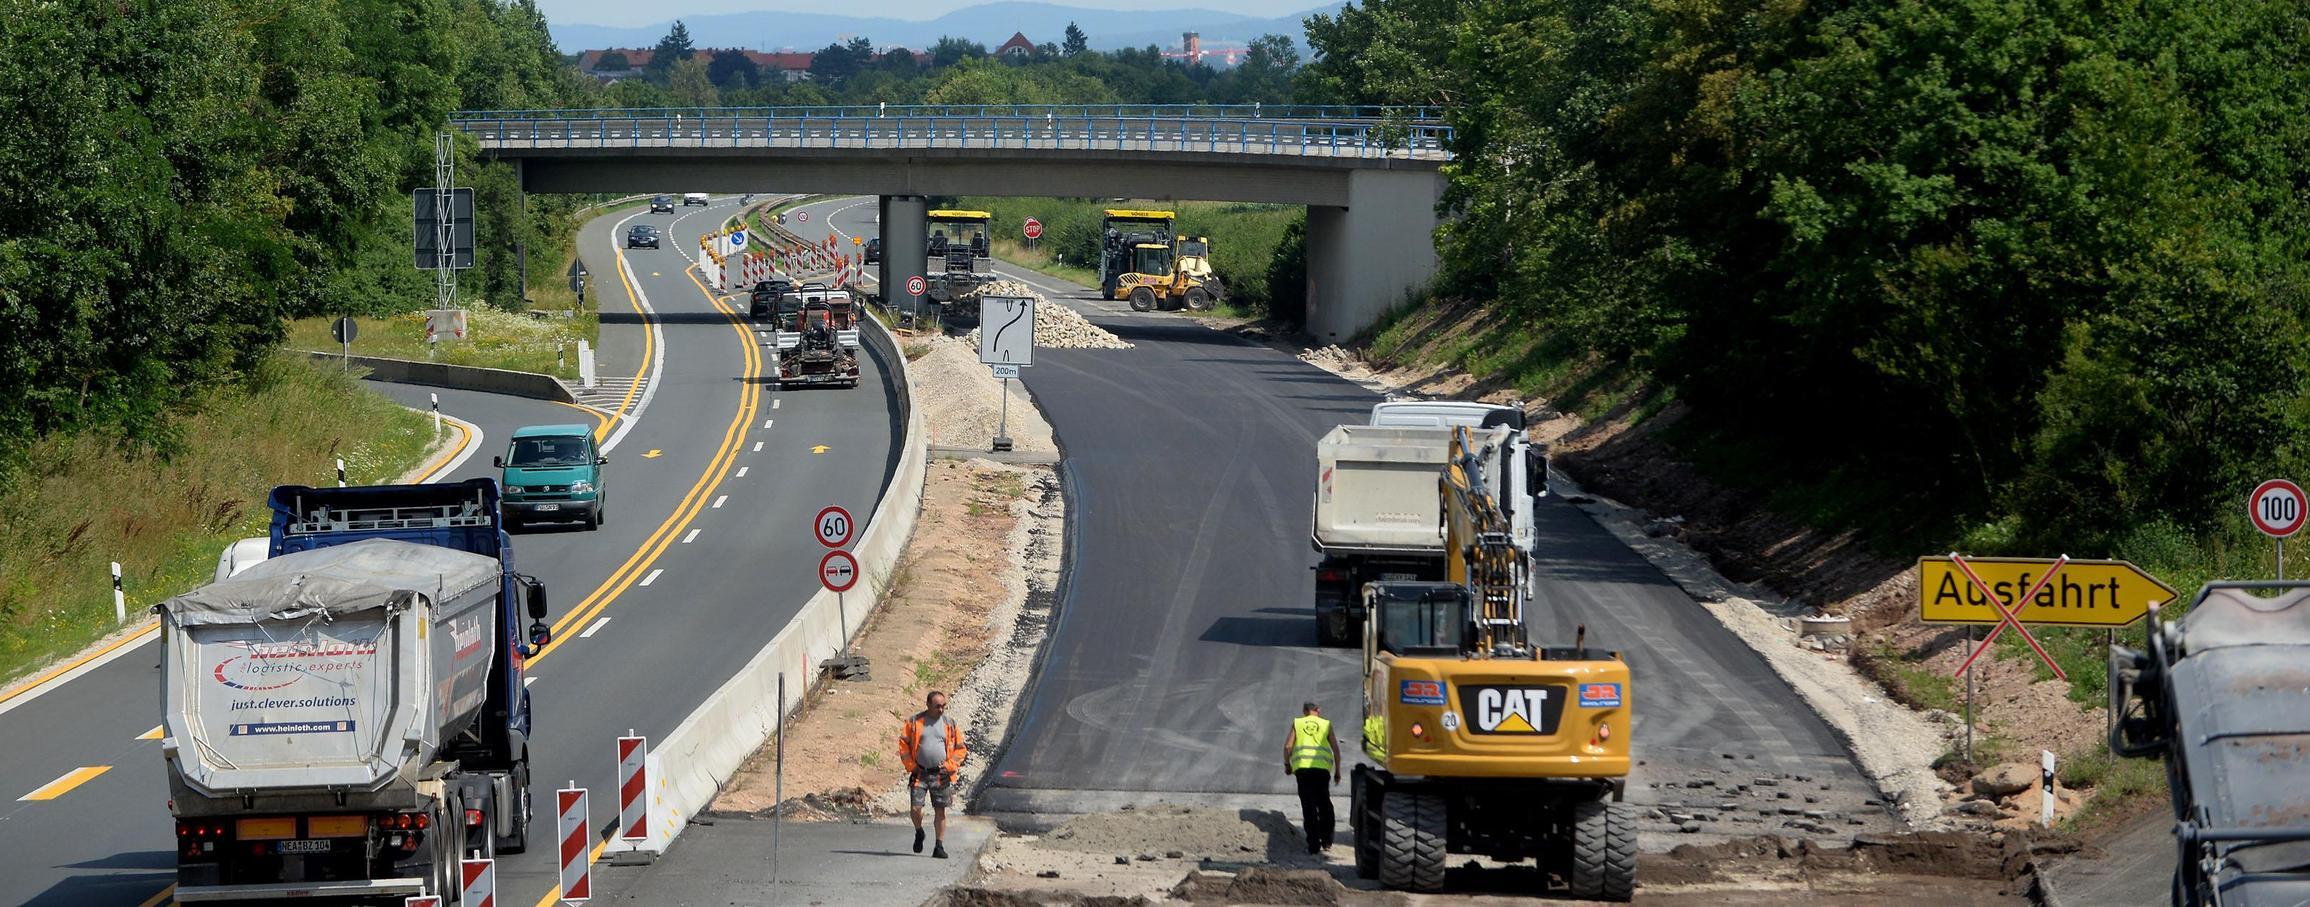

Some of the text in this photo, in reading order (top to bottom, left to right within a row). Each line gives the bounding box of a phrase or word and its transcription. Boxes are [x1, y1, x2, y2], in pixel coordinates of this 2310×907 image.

[1025, 225, 1040, 233] STOP
[910, 281, 921, 291] 60
[995, 366, 1017, 376] 200m
[2261, 496, 2296, 521] 100
[823, 517, 845, 537] 60
[1933, 571, 2120, 609] Ausfahrt
[231, 695, 356, 711] just.clever.solutions
[1478, 688, 1547, 732] CAT
[1445, 714, 1457, 728] 20
[255, 723, 331, 734] www.heinloth.com
[281, 840, 330, 851] NEA BZ 104
